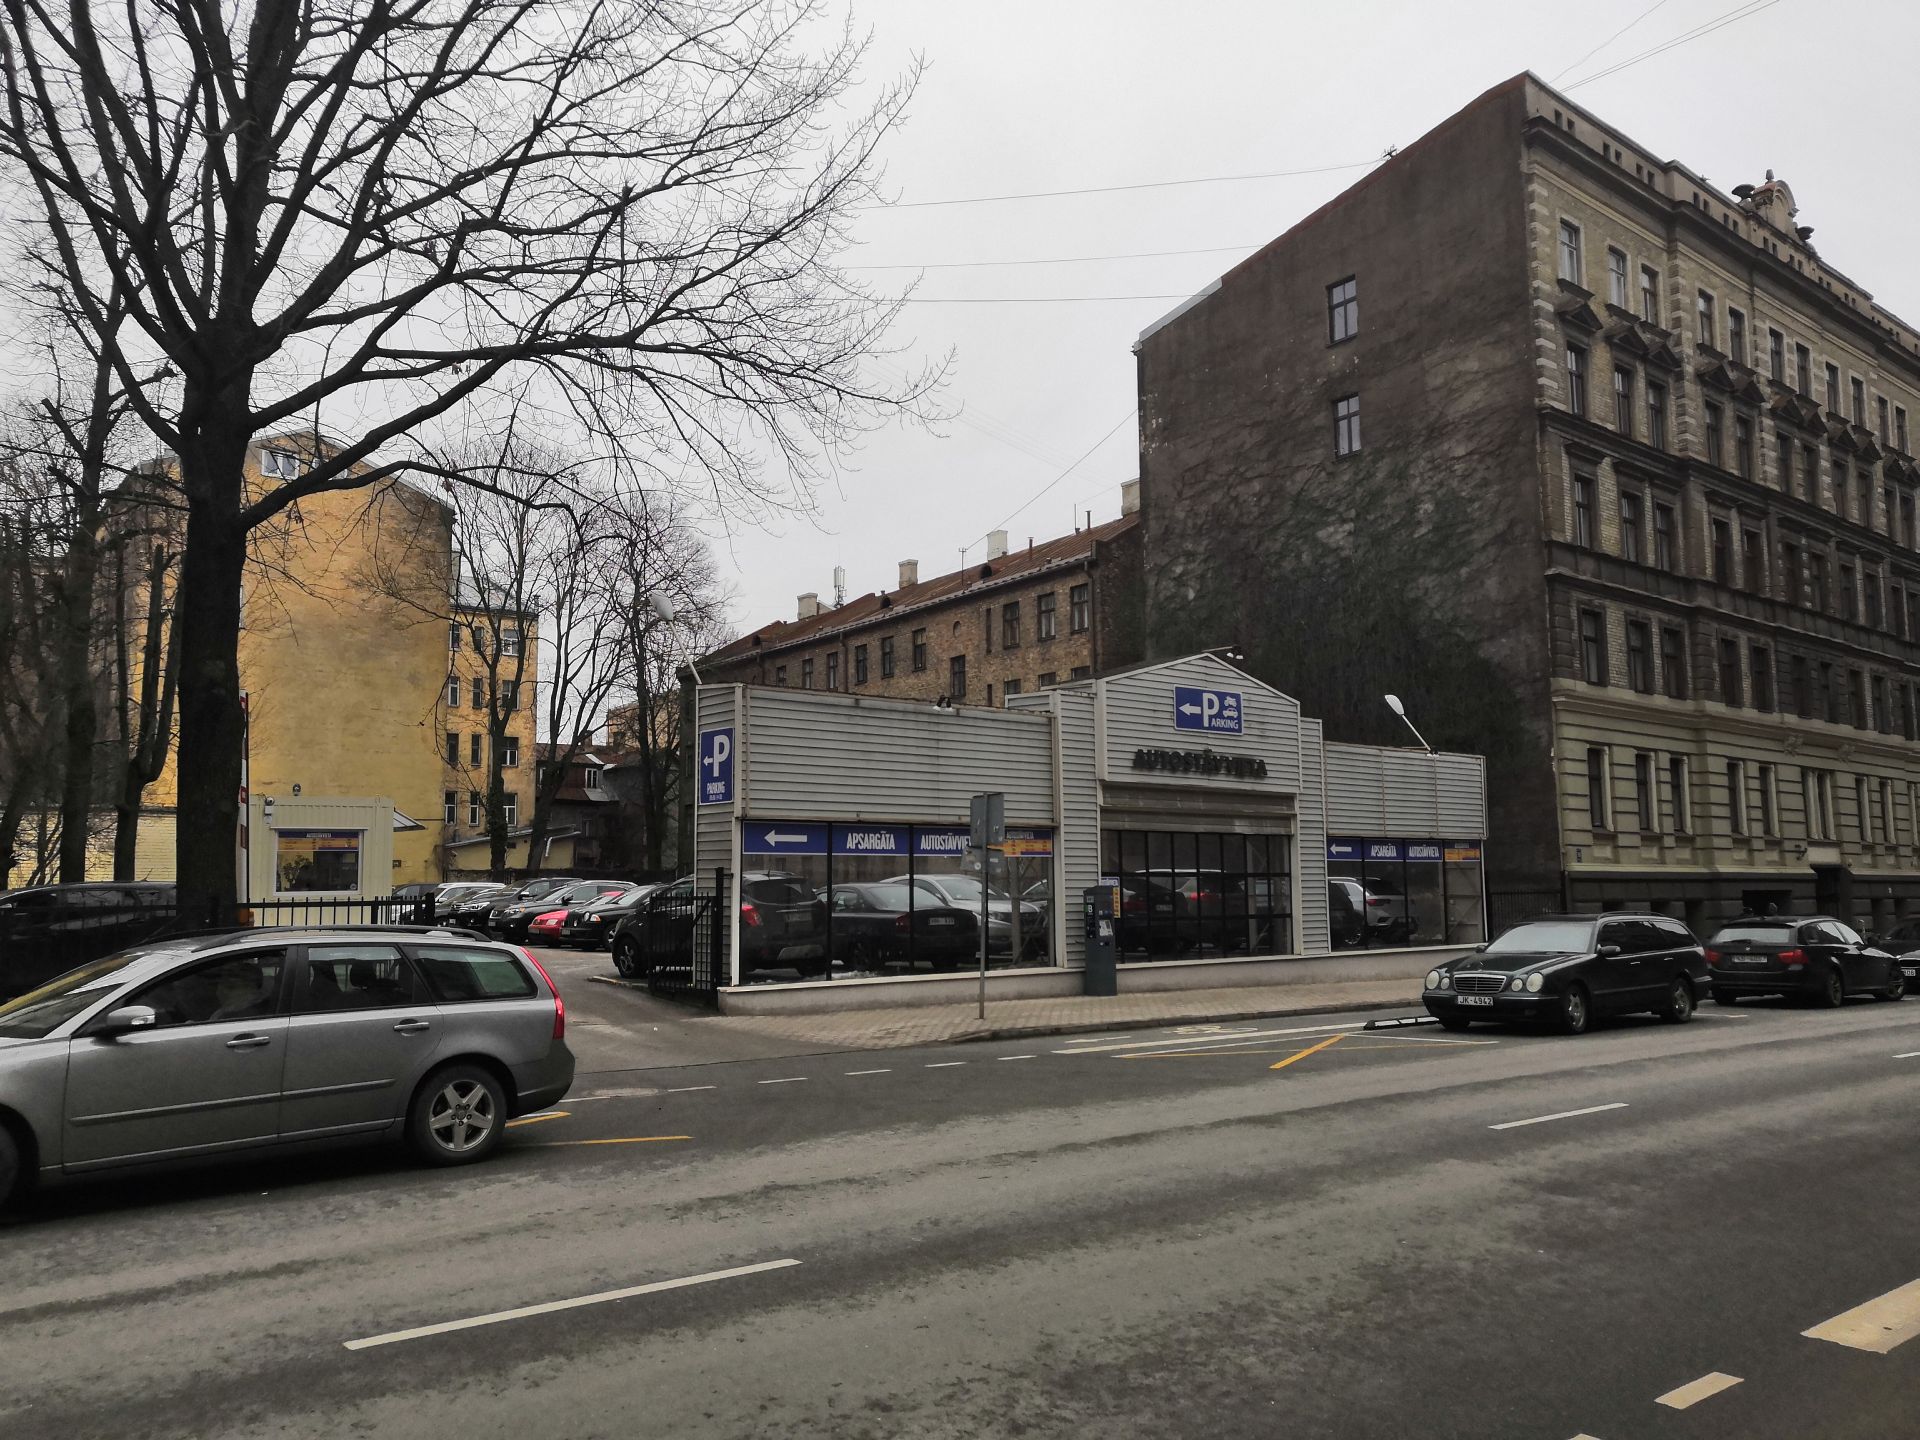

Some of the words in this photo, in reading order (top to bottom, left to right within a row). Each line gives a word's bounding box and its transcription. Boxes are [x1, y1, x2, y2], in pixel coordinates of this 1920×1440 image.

[713, 734, 730, 777] P
[846, 831, 896, 850] APSARGĀTA
[920, 832, 972, 851] AUTOSTĀVVIET
